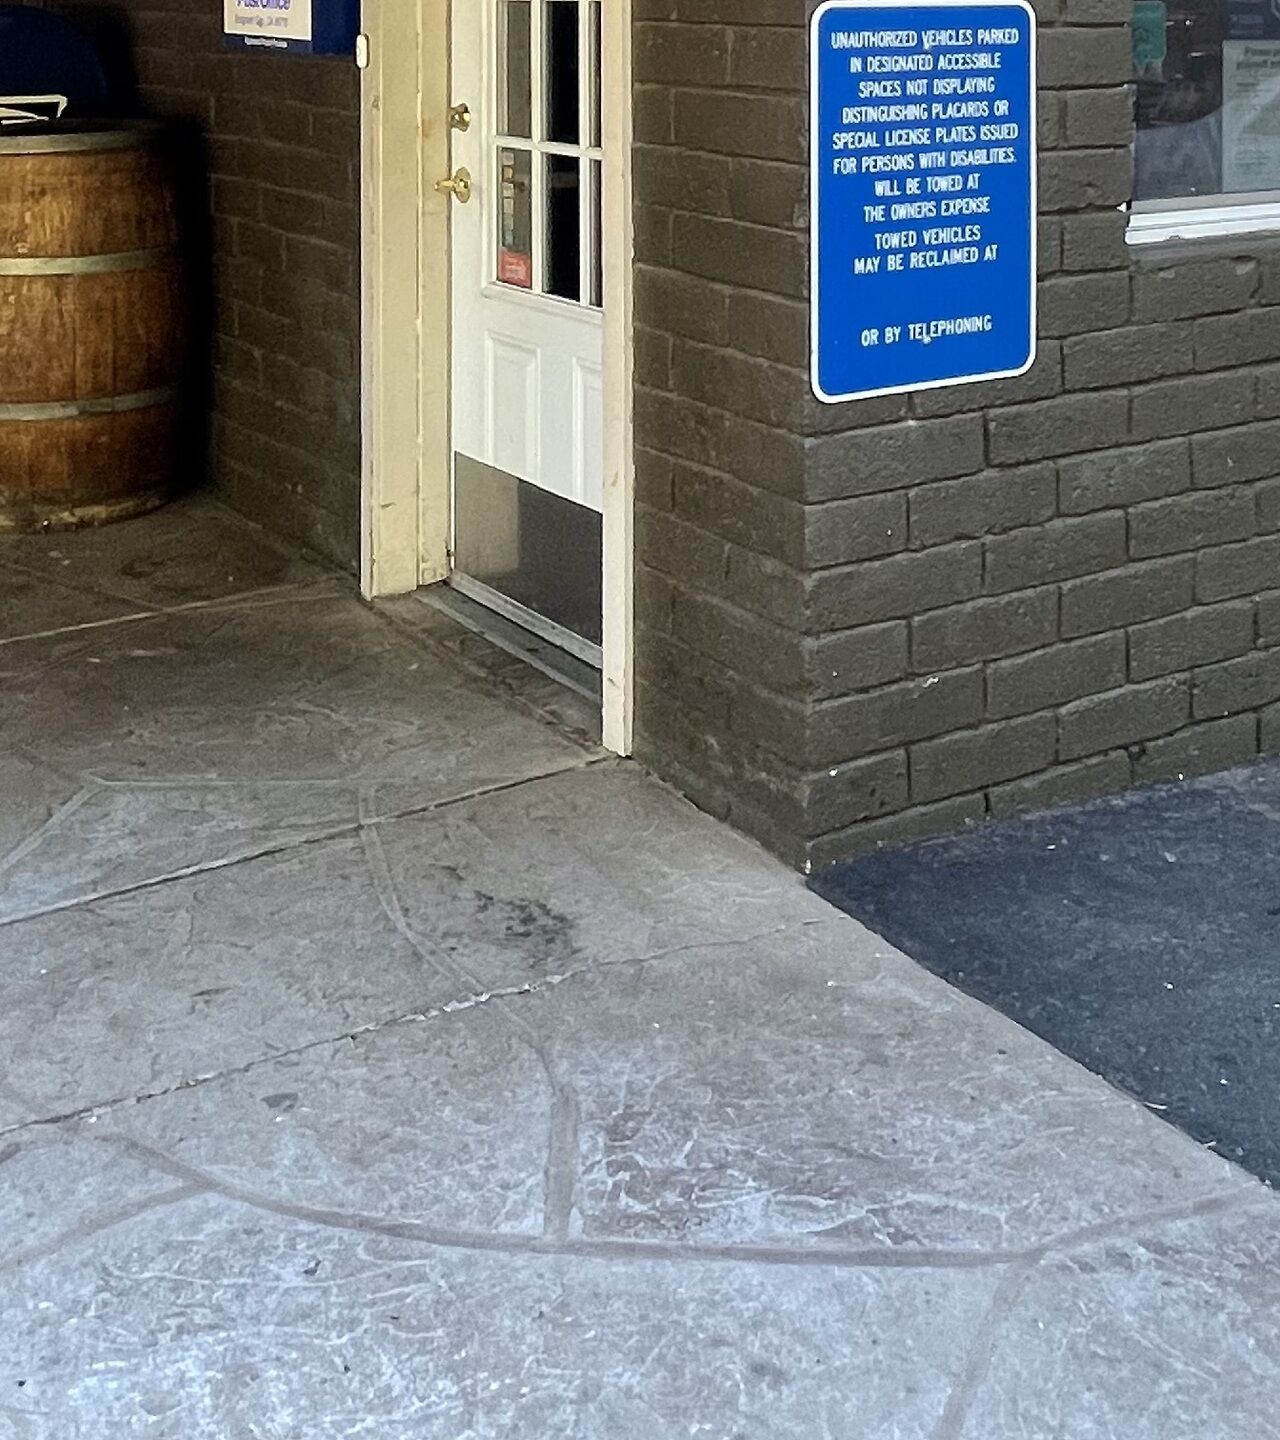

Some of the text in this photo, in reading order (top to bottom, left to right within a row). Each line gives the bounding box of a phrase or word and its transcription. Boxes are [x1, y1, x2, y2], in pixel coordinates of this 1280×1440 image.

[831, 28, 1019, 49] UNAUTHORIZED VEHICLES PARKED
[850, 52, 1002, 73] IN DESIGNATED ACCESSIBLE
[858, 77, 995, 98] SPACES NOT DISPLAYING
[842, 100, 1009, 124] DISTINGUISHING PLACARDS OR
[832, 123, 1019, 150] SPECIAL LICENSE PLATES ISSUED
[833, 157, 857, 175] FOR
[861, 154, 914, 173] PERSONS
[919, 151, 946, 169] WITH
[874, 173, 981, 197] WILL BE TOWED AT
[863, 196, 991, 223] THE OWNERS EXPENSE
[875, 225, 981, 250] TOWED VEHICLES
[854, 244, 998, 275] MAY BE RECLAIMED AT
[861, 315, 992, 346] OR BY TELEPHONING
